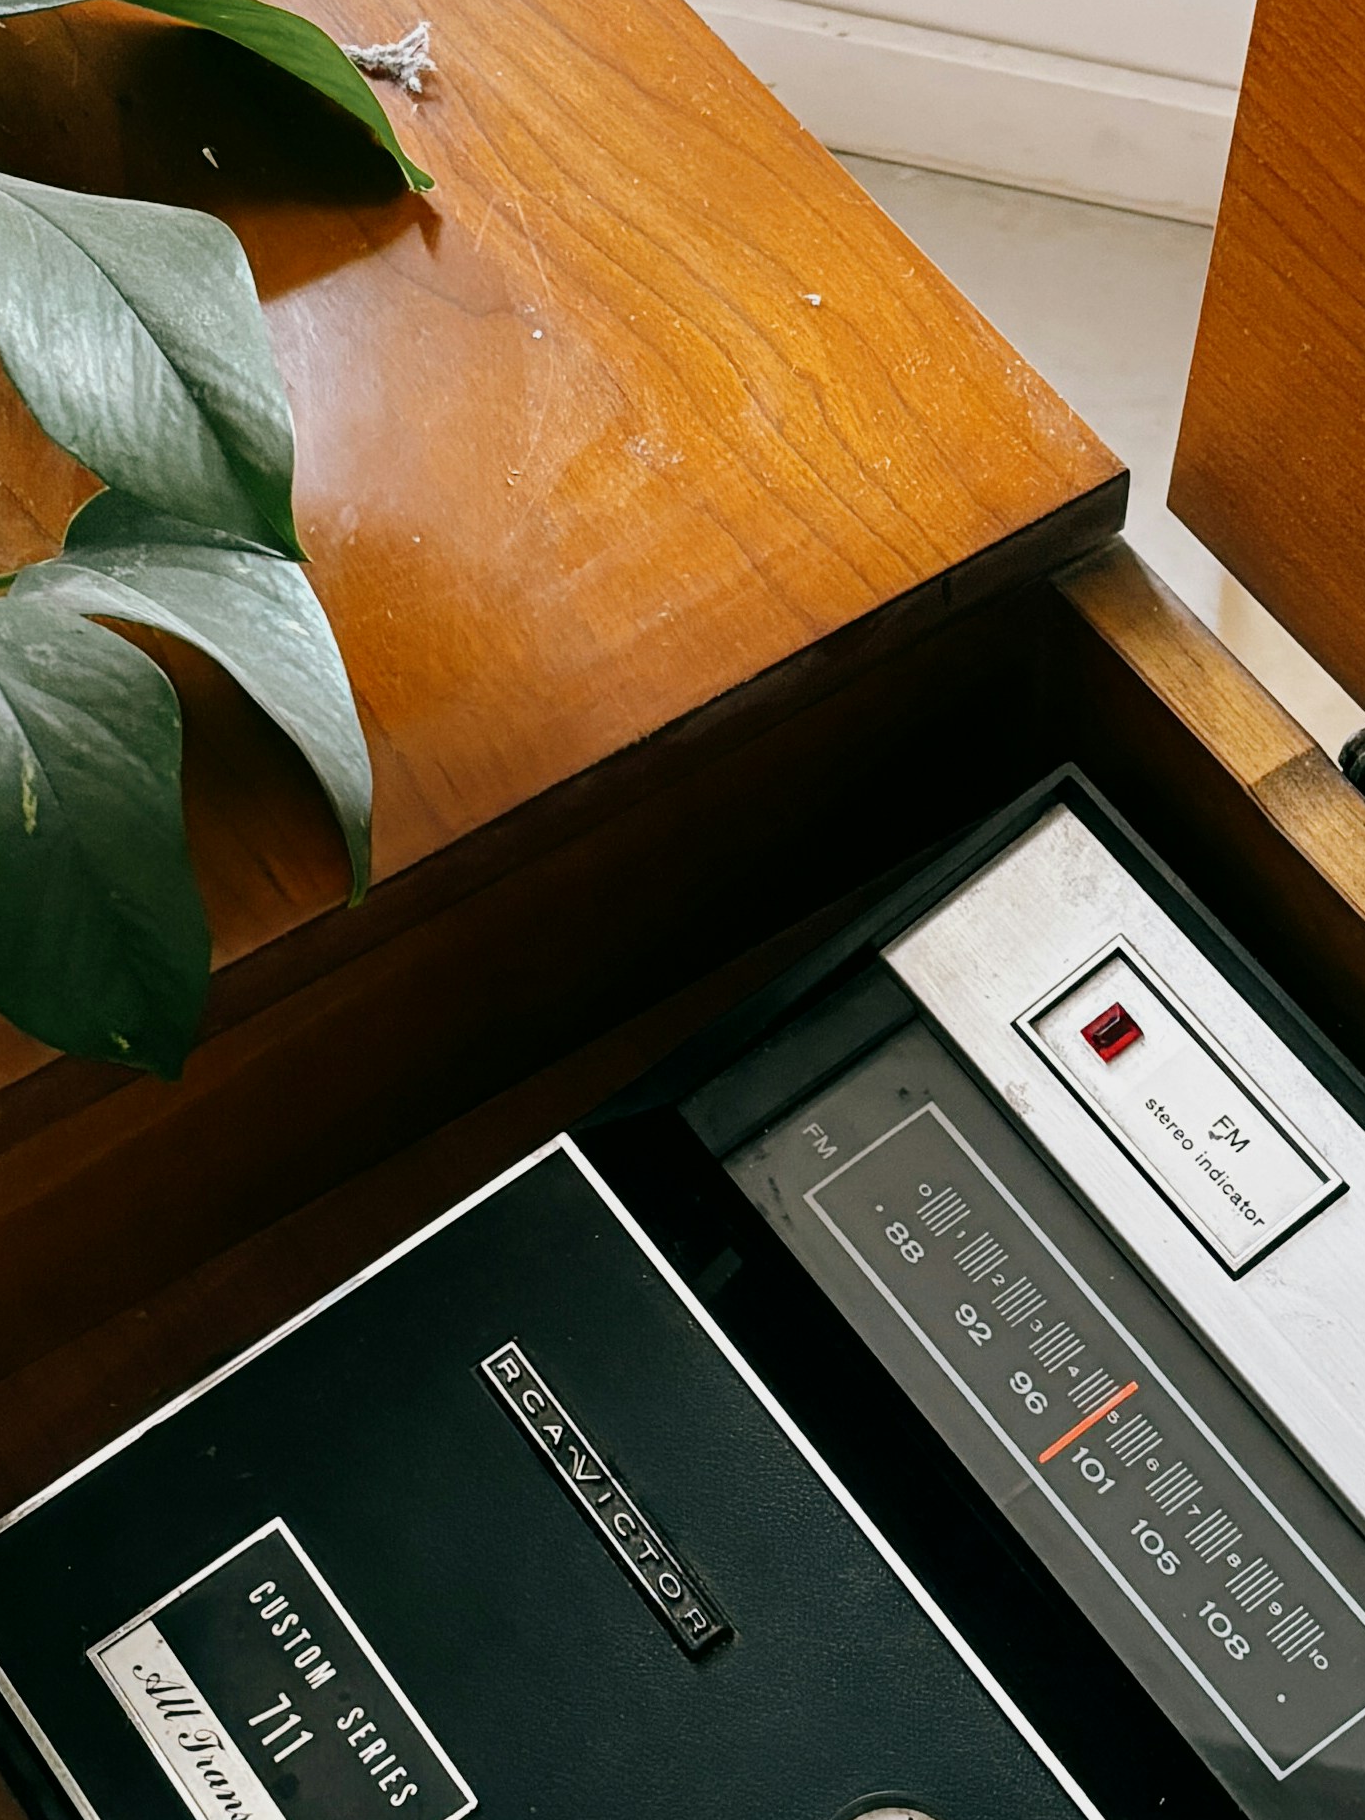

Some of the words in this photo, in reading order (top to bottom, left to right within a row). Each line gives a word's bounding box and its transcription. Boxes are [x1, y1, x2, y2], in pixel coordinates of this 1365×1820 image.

[801, 1121, 838, 1160] FM
[1144, 1097, 1194, 1151] stereo
[1194, 1150, 1265, 1226] indicator
[1211, 1113, 1251, 1153] FM
[496, 1356, 563, 1445] RCA
[567, 1444, 707, 1633] VICTOR
[884, 1220, 925, 1264] 88
[954, 1302, 992, 1347] 92
[1008, 1370, 1048, 1415] 96
[1070, 1445, 1116, 1495] 101
[1129, 1518, 1181, 1575] 105
[1197, 1599, 1251, 1661] 108
[990, 1272, 1006, 1287] 2
[1028, 1318, 1043, 1333] 3
[1066, 1365, 1080, 1378] 4
[1105, 1409, 1120, 1424] 5
[1145, 1456, 1160, 1472] 6
[1186, 1503, 1201, 1515] 7
[1225, 1551, 1242, 1568] 8
[1267, 1600, 1283, 1616] 9
[1307, 1647, 1329, 1670] 10
[131, 1663, 202, 1720] All
[247, 1580, 337, 1690] CUSTOM
[335, 1706, 418, 1807] SERIES
[247, 1691, 314, 1763] 711
